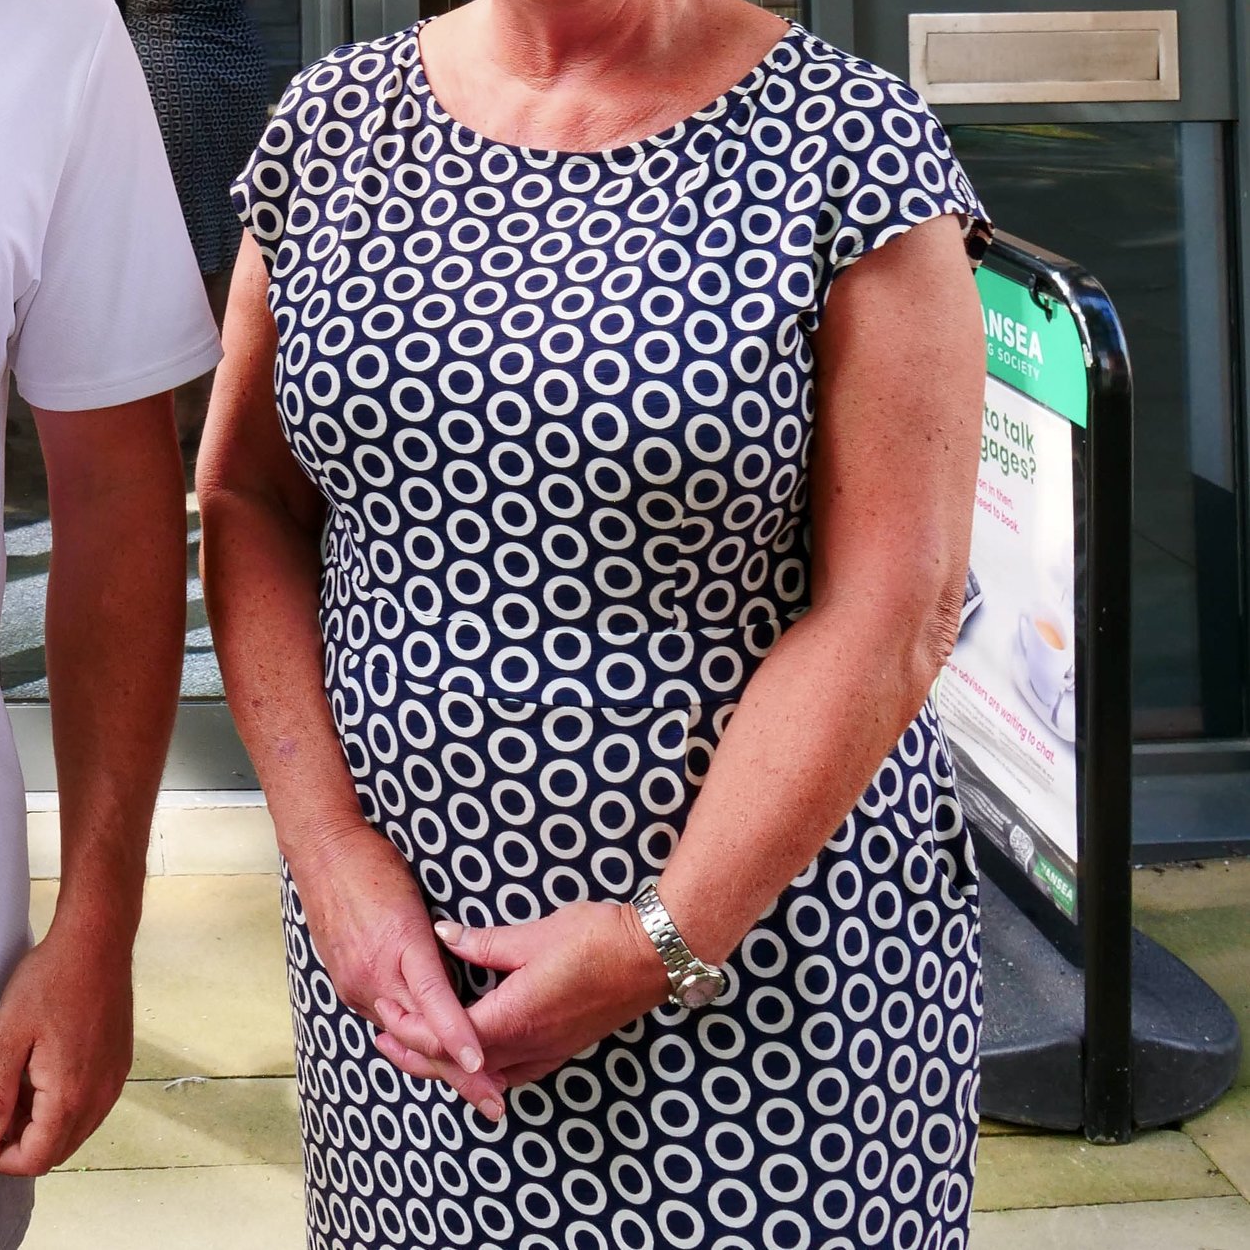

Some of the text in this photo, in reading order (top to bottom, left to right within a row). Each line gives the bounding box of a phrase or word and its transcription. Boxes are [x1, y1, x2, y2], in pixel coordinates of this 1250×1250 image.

[997, 348, 1041, 382] SOCIETY
[984, 401, 1035, 454] to talk
[958, 669, 988, 702] advisers
[988, 696, 1000, 712] are
[1000, 707, 1027, 741] waiting
[1027, 731, 1035, 746] to
